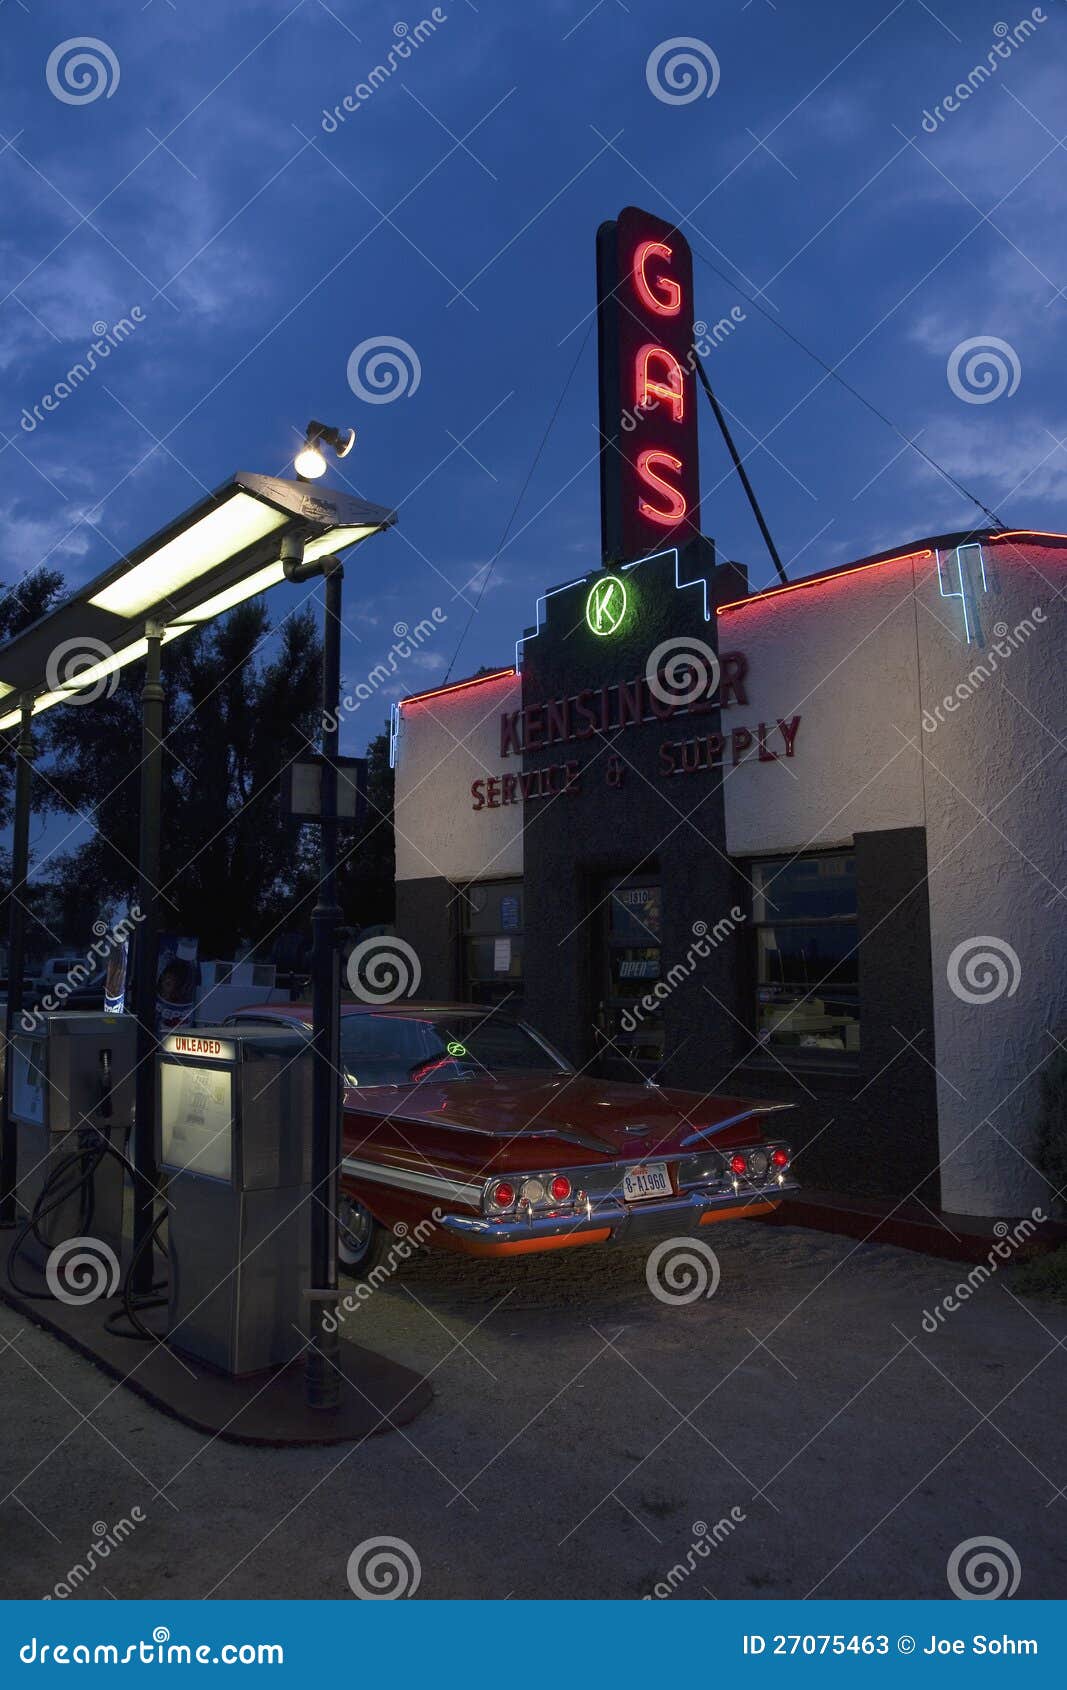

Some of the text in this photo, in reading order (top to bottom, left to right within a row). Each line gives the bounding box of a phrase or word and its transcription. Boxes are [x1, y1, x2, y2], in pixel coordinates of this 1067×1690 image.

[633, 240, 686, 526] GAS
[471, 715, 802, 811] SERVICE & SUPPLY
[175, 1037, 221, 1054] UNLEADED
[625, 1173, 667, 1194] 8-A1960
